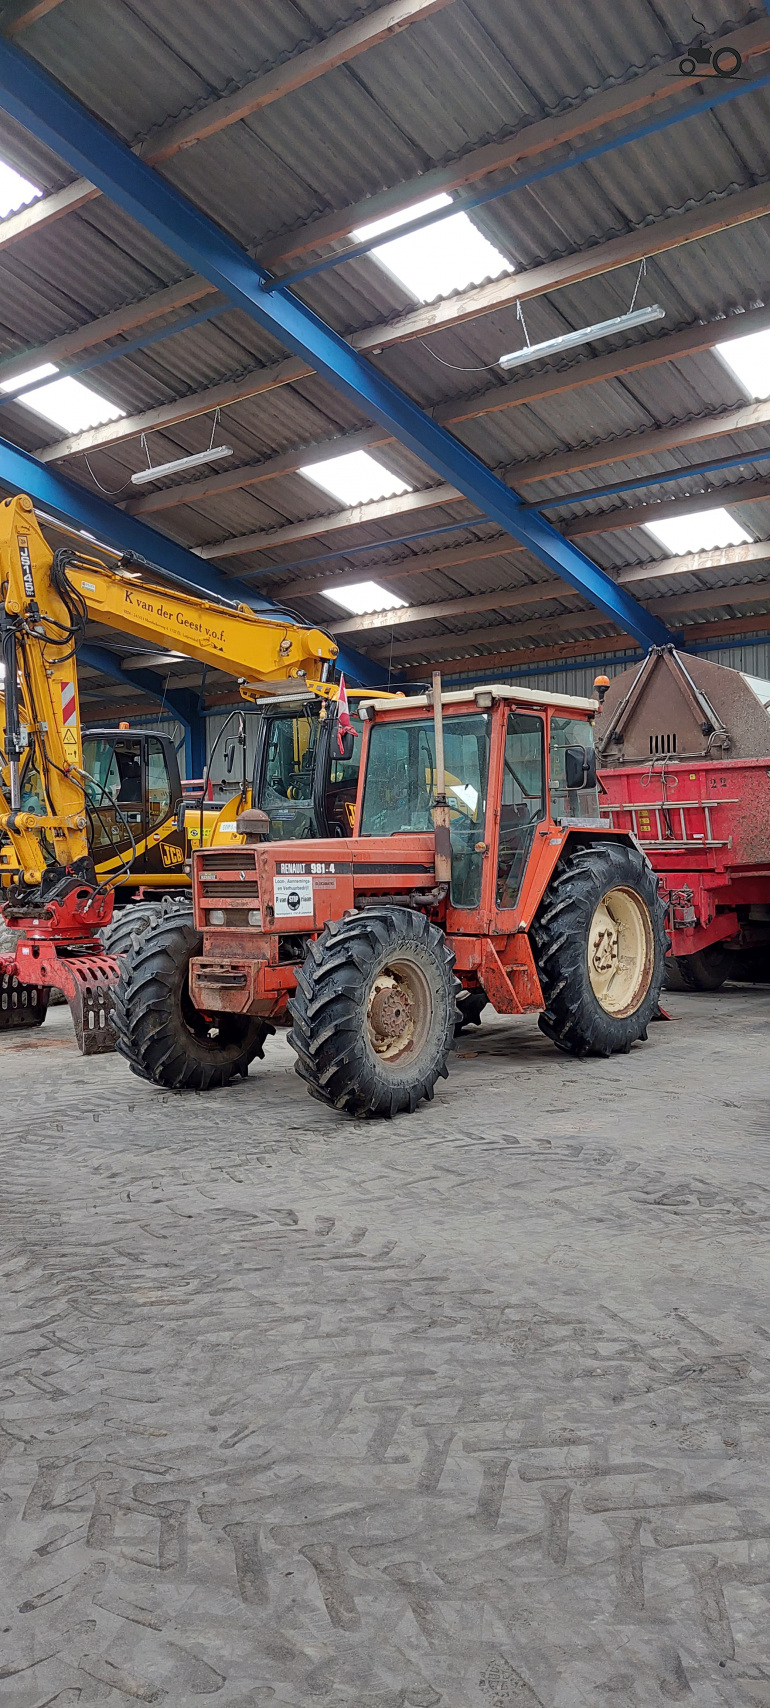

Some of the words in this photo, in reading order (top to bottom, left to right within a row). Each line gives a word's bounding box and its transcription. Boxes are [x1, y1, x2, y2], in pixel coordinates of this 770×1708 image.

[124, 589, 133, 604] K
[136, 598, 154, 613] van
[156, 604, 173, 620] der
[176, 612, 202, 632] Geest
[205, 627, 226, 642] v.o.f.
[162, 845, 184, 866] JCB
[280, 863, 306, 874] RENAULT
[310, 863, 335, 874] 981-4
